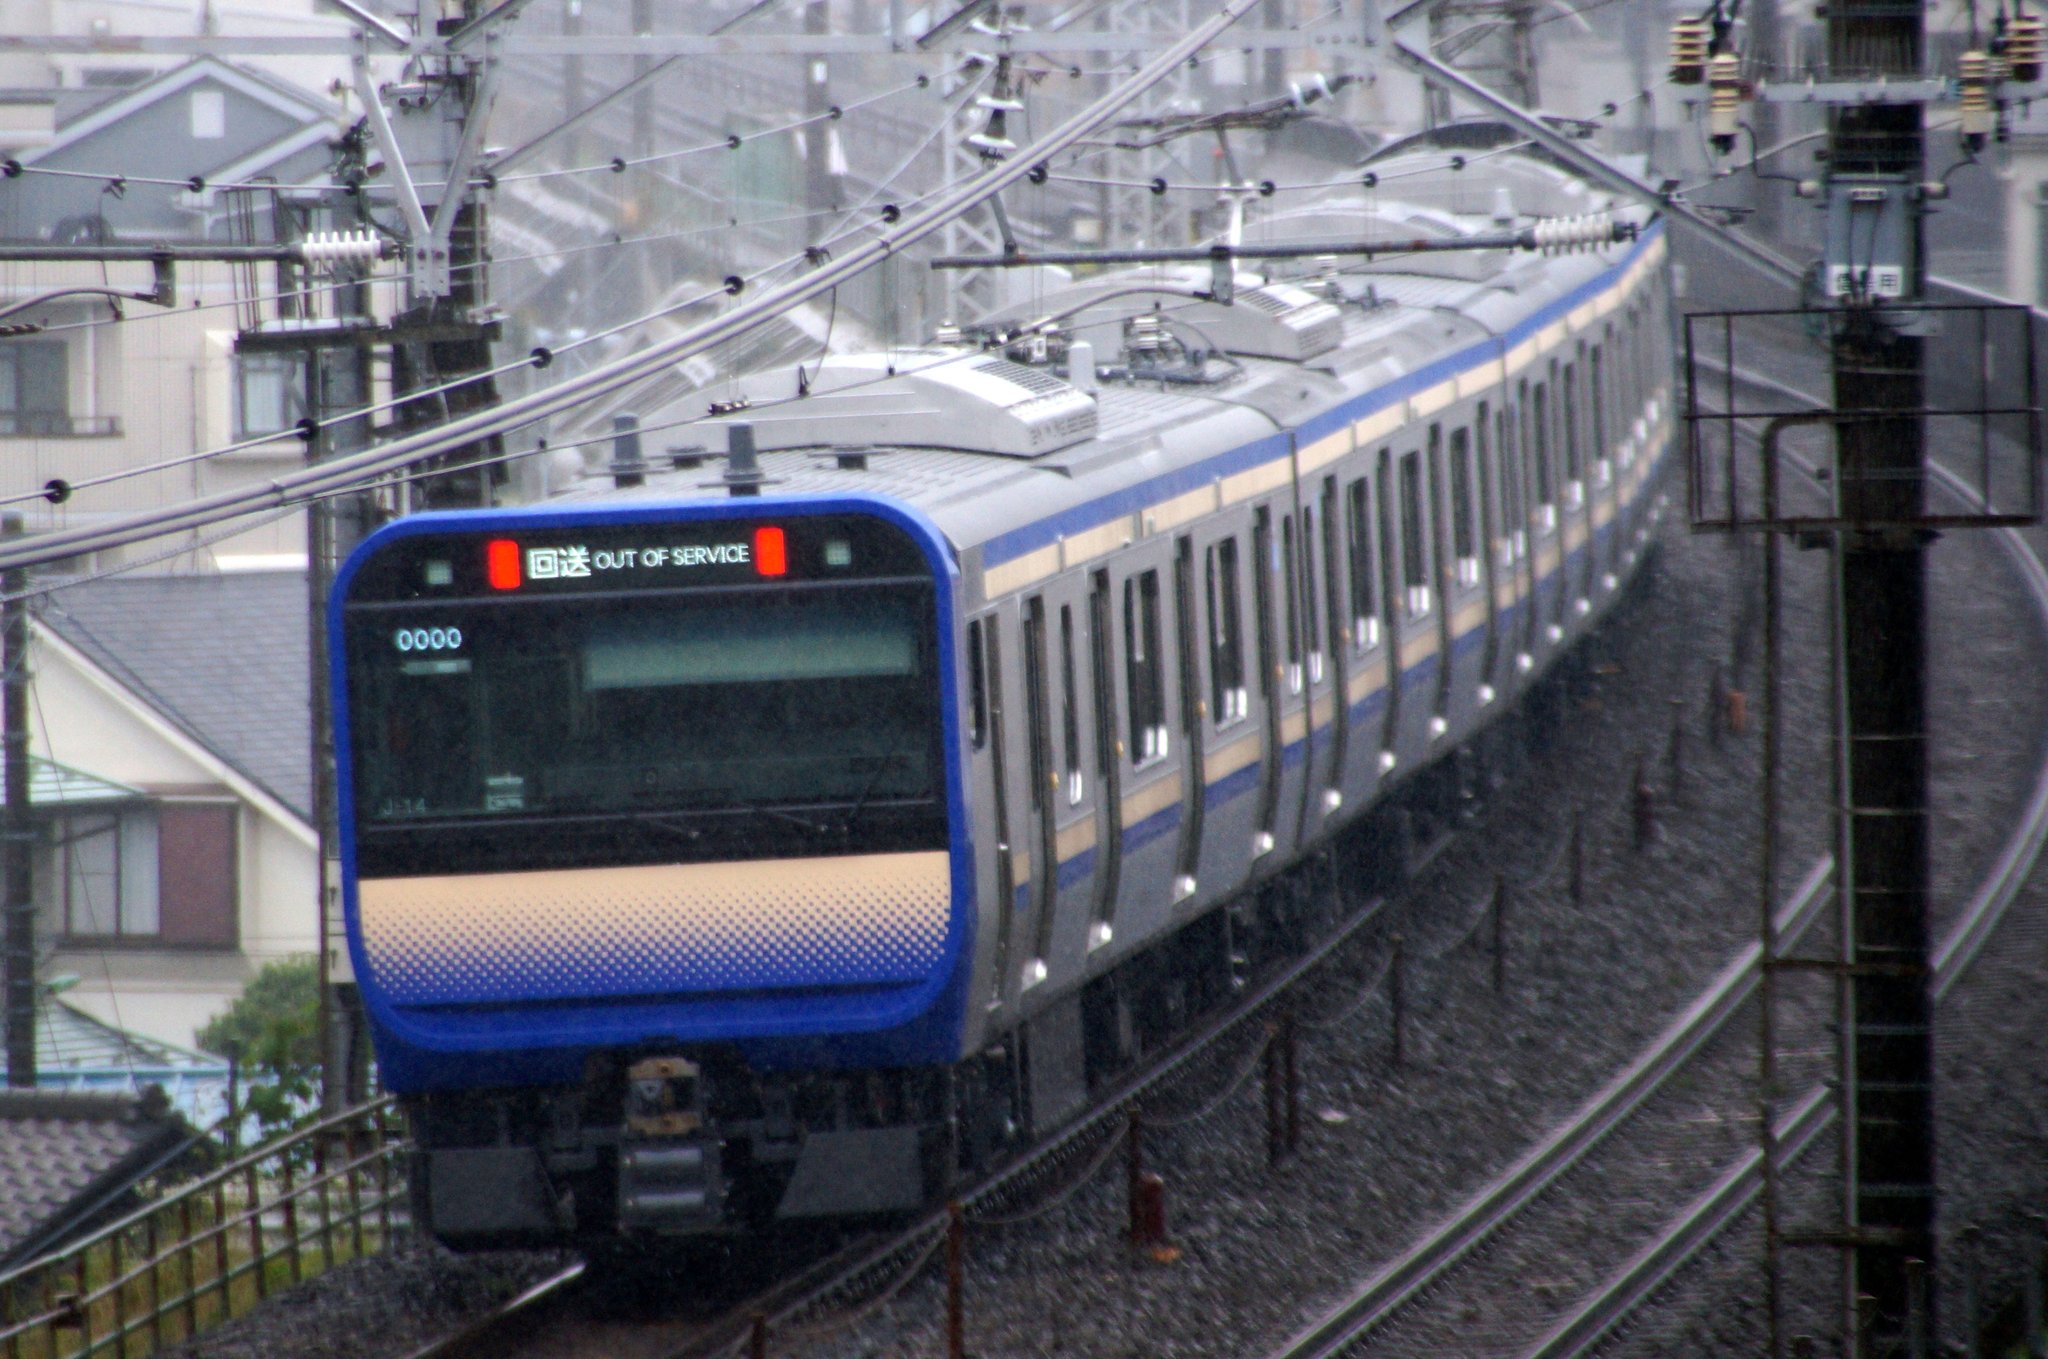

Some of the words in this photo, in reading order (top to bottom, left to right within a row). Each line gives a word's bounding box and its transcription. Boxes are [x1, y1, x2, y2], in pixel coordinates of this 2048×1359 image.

[1837, 272, 1898, 292] 信用
[528, 545, 592, 579] 回送
[595, 549, 638, 570] OUT
[641, 548, 669, 567] OF
[672, 544, 750, 566] SERVICE
[396, 627, 462, 651] 0000
